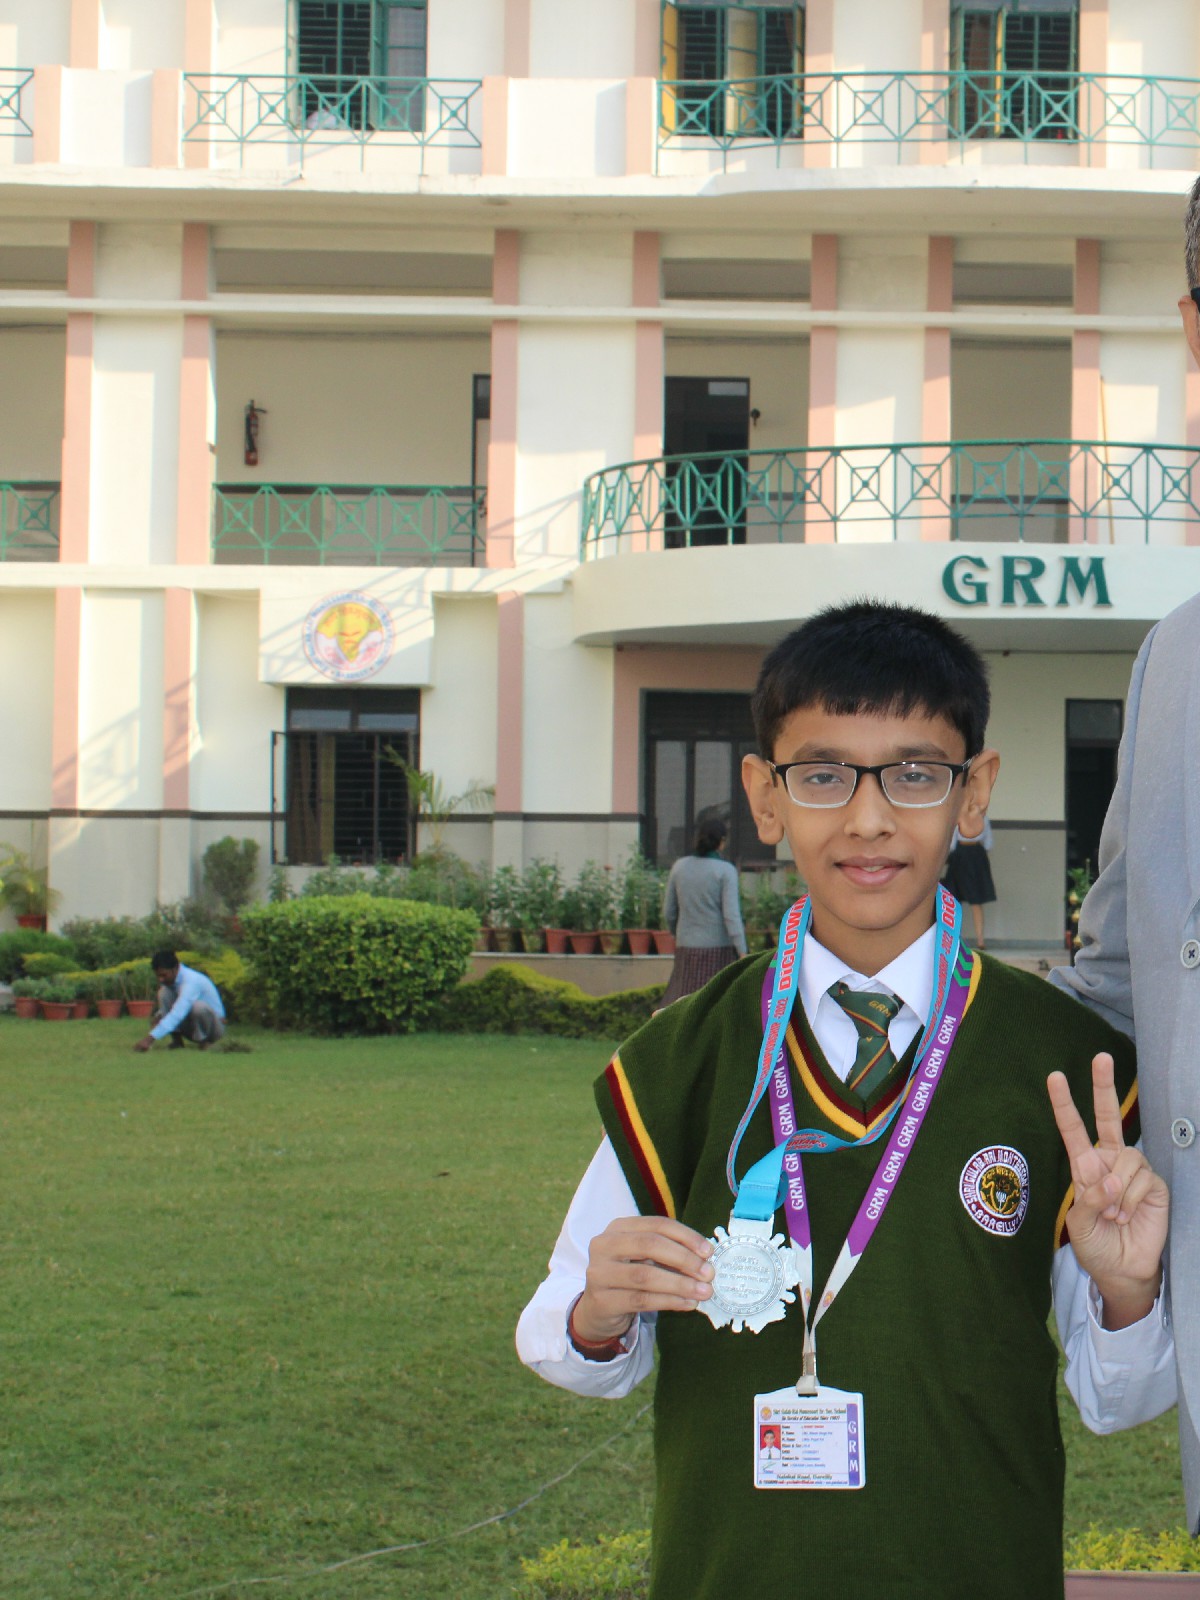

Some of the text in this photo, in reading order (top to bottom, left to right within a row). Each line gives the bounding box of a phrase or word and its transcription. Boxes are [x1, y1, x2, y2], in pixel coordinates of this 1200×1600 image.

[942, 555, 1113, 607] GRM
[869, 1000, 891, 1018] GRM
[774, 1066, 788, 1099] GRM
[779, 1103, 794, 1135] GRM
[866, 1187, 888, 1220] GRM
[882, 1150, 904, 1183] GRM
[897, 1115, 919, 1147] GRM
[912, 1081, 933, 1111] GRM
[924, 1048, 945, 1078] GRM
[937, 1015, 957, 1044] GRM
[785, 1153, 799, 1172] GR
[965, 1156, 987, 1184] GULAB
[788, 1177, 804, 1210] GRM
[974, 1209, 1016, 1232] BAREILLY
